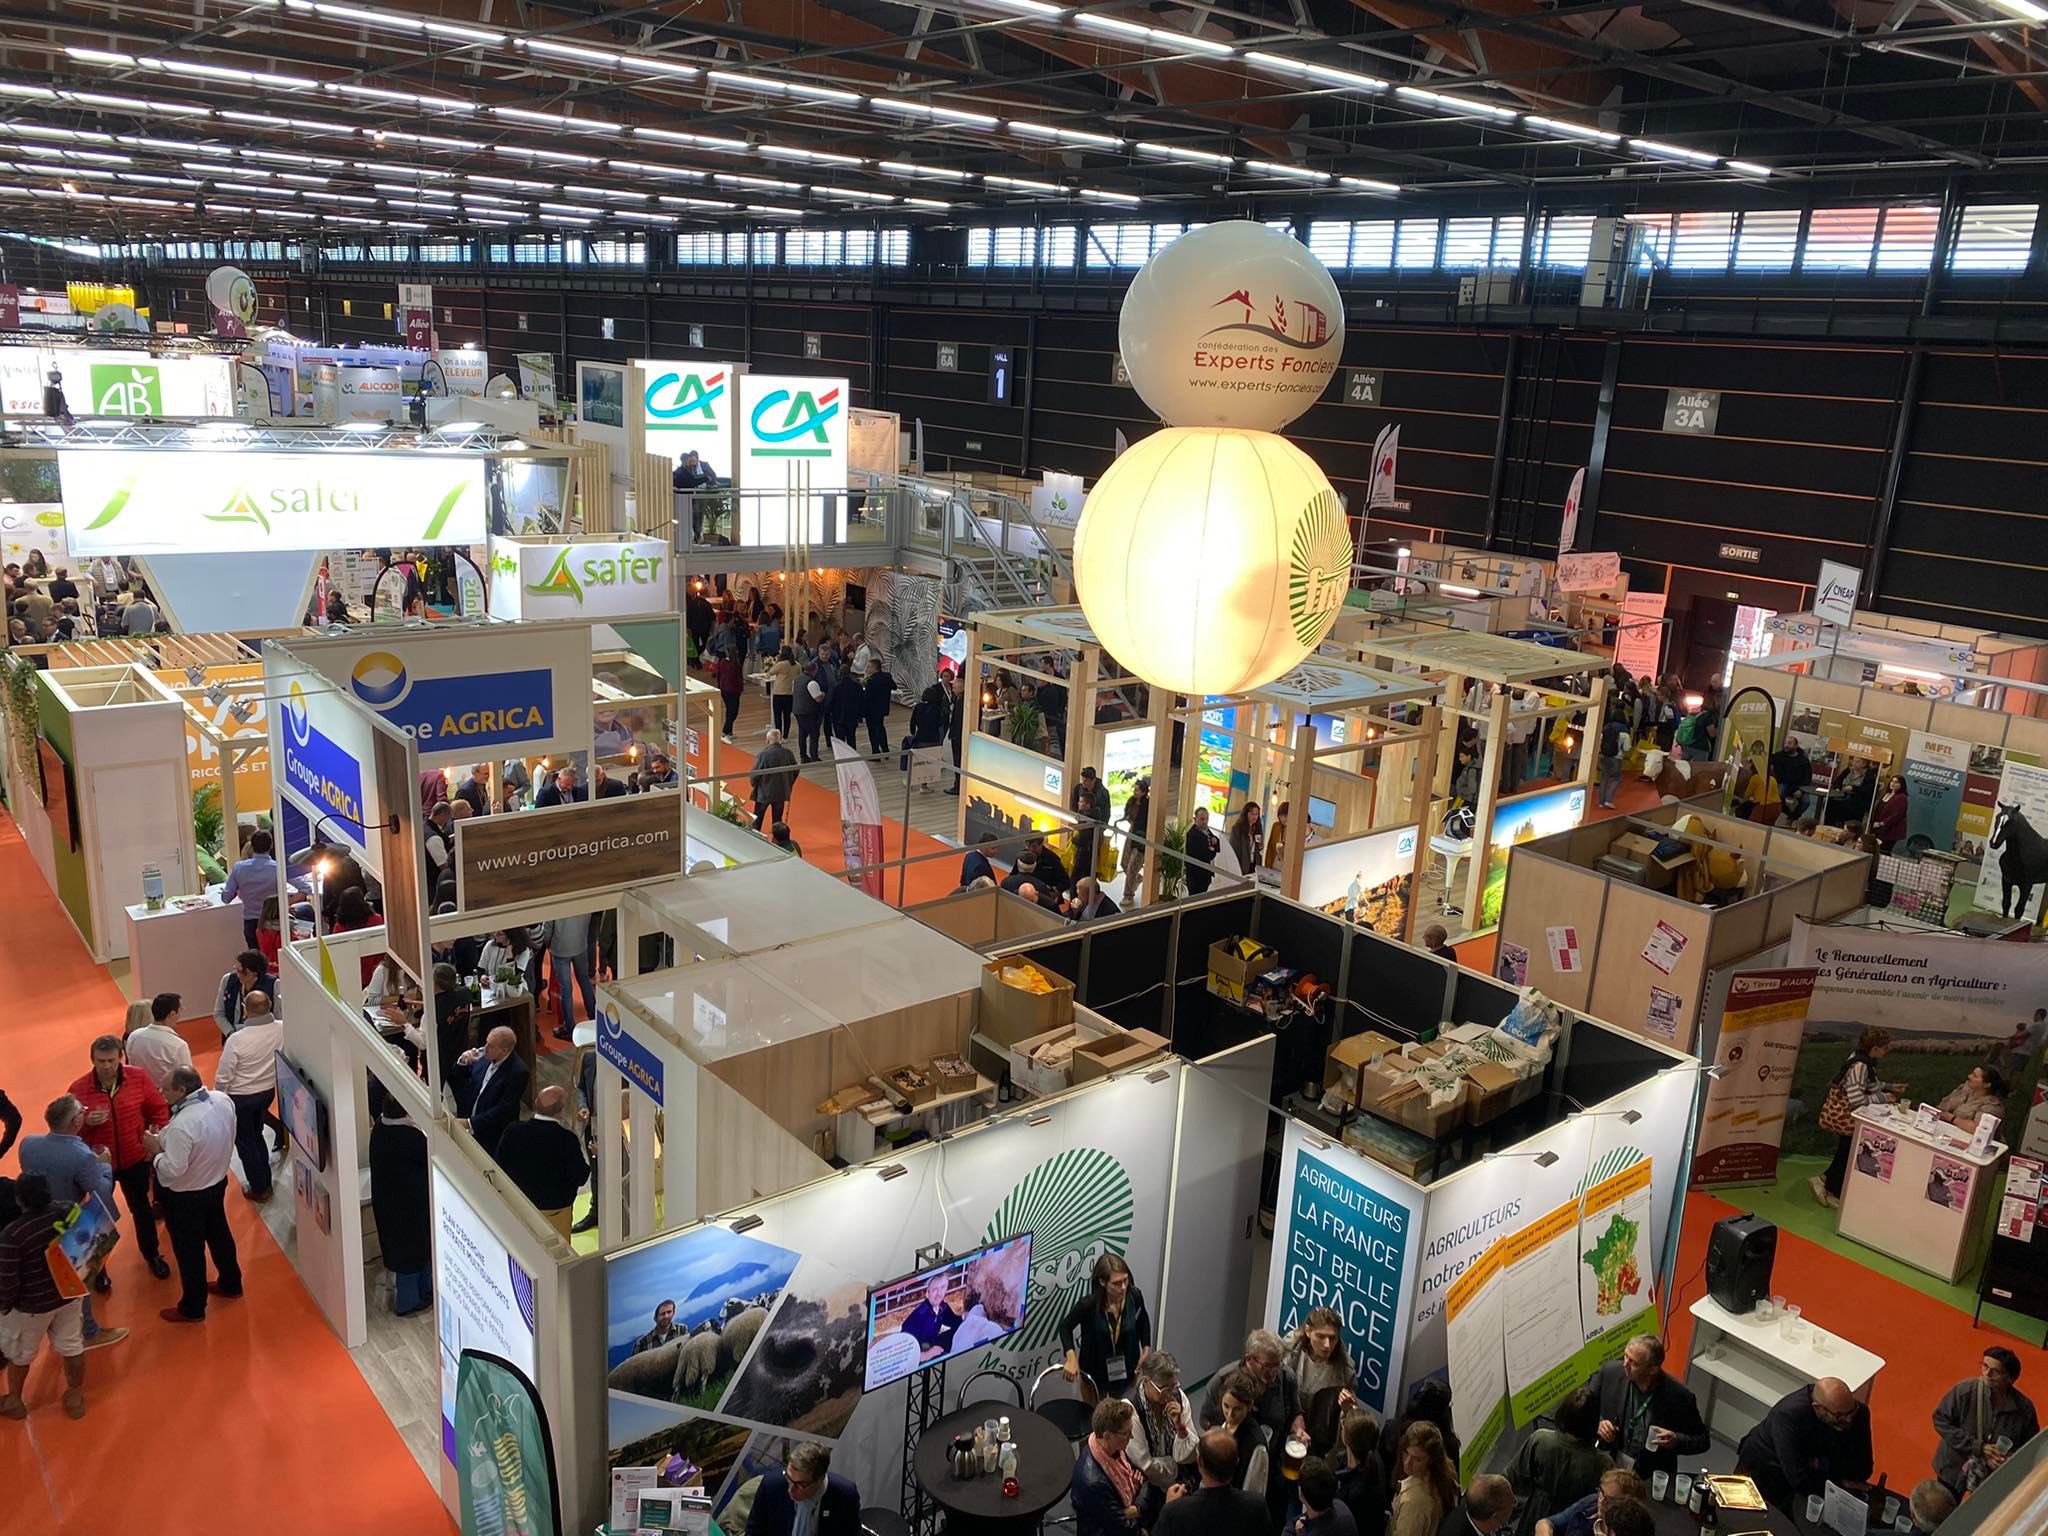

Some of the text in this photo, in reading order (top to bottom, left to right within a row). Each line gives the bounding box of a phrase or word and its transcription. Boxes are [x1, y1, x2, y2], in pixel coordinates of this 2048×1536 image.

[994, 353, 1008, 362] HALL
[1197, 341, 1278, 353] confédération des
[941, 355, 953, 367] 6A
[1193, 351, 1335, 374] Experts Fonciers
[996, 368, 1005, 399] 1
[1352, 374, 1376, 384] Allée
[99, 382, 152, 416] AB
[1351, 385, 1374, 401] 4A
[1677, 395, 1710, 409] Allée
[1674, 409, 1706, 429] 3A
[1721, 546, 1759, 559] SORTIE
[583, 548, 664, 587] safer
[1833, 584, 1855, 600] CNEAP
[439, 706, 544, 737] AGRICA
[251, 761, 267, 771] ET
[1907, 769, 1961, 787] APPRENTISSAGE
[1910, 762, 1952, 777] ALTERNANCE
[287, 748, 362, 828] Groupe AGRICA
[477, 827, 670, 871] www.groupagrica.com
[1816, 948, 1928, 969] Le Renouvellement
[1835, 966, 1908, 984] Générations
[1911, 975, 1925, 985] en
[1928, 974, 2000, 991] Agriculture
[600, 1035, 661, 1097] Groupe AGRICA
[1300, 1164, 1403, 1233] AGRICULTEURS
[1298, 1194, 1399, 1272] LA FRANCE
[1425, 1197, 1522, 1262] AGRICULTEURS
[1293, 1230, 1328, 1268] EST
[1331, 1253, 1394, 1310] BELLE
[1422, 1257, 1465, 1295] notre
[1283, 1297, 1299, 1332] À
[1290, 1263, 1390, 1352] GRÂCE
[1417, 1300, 1437, 1322] est
